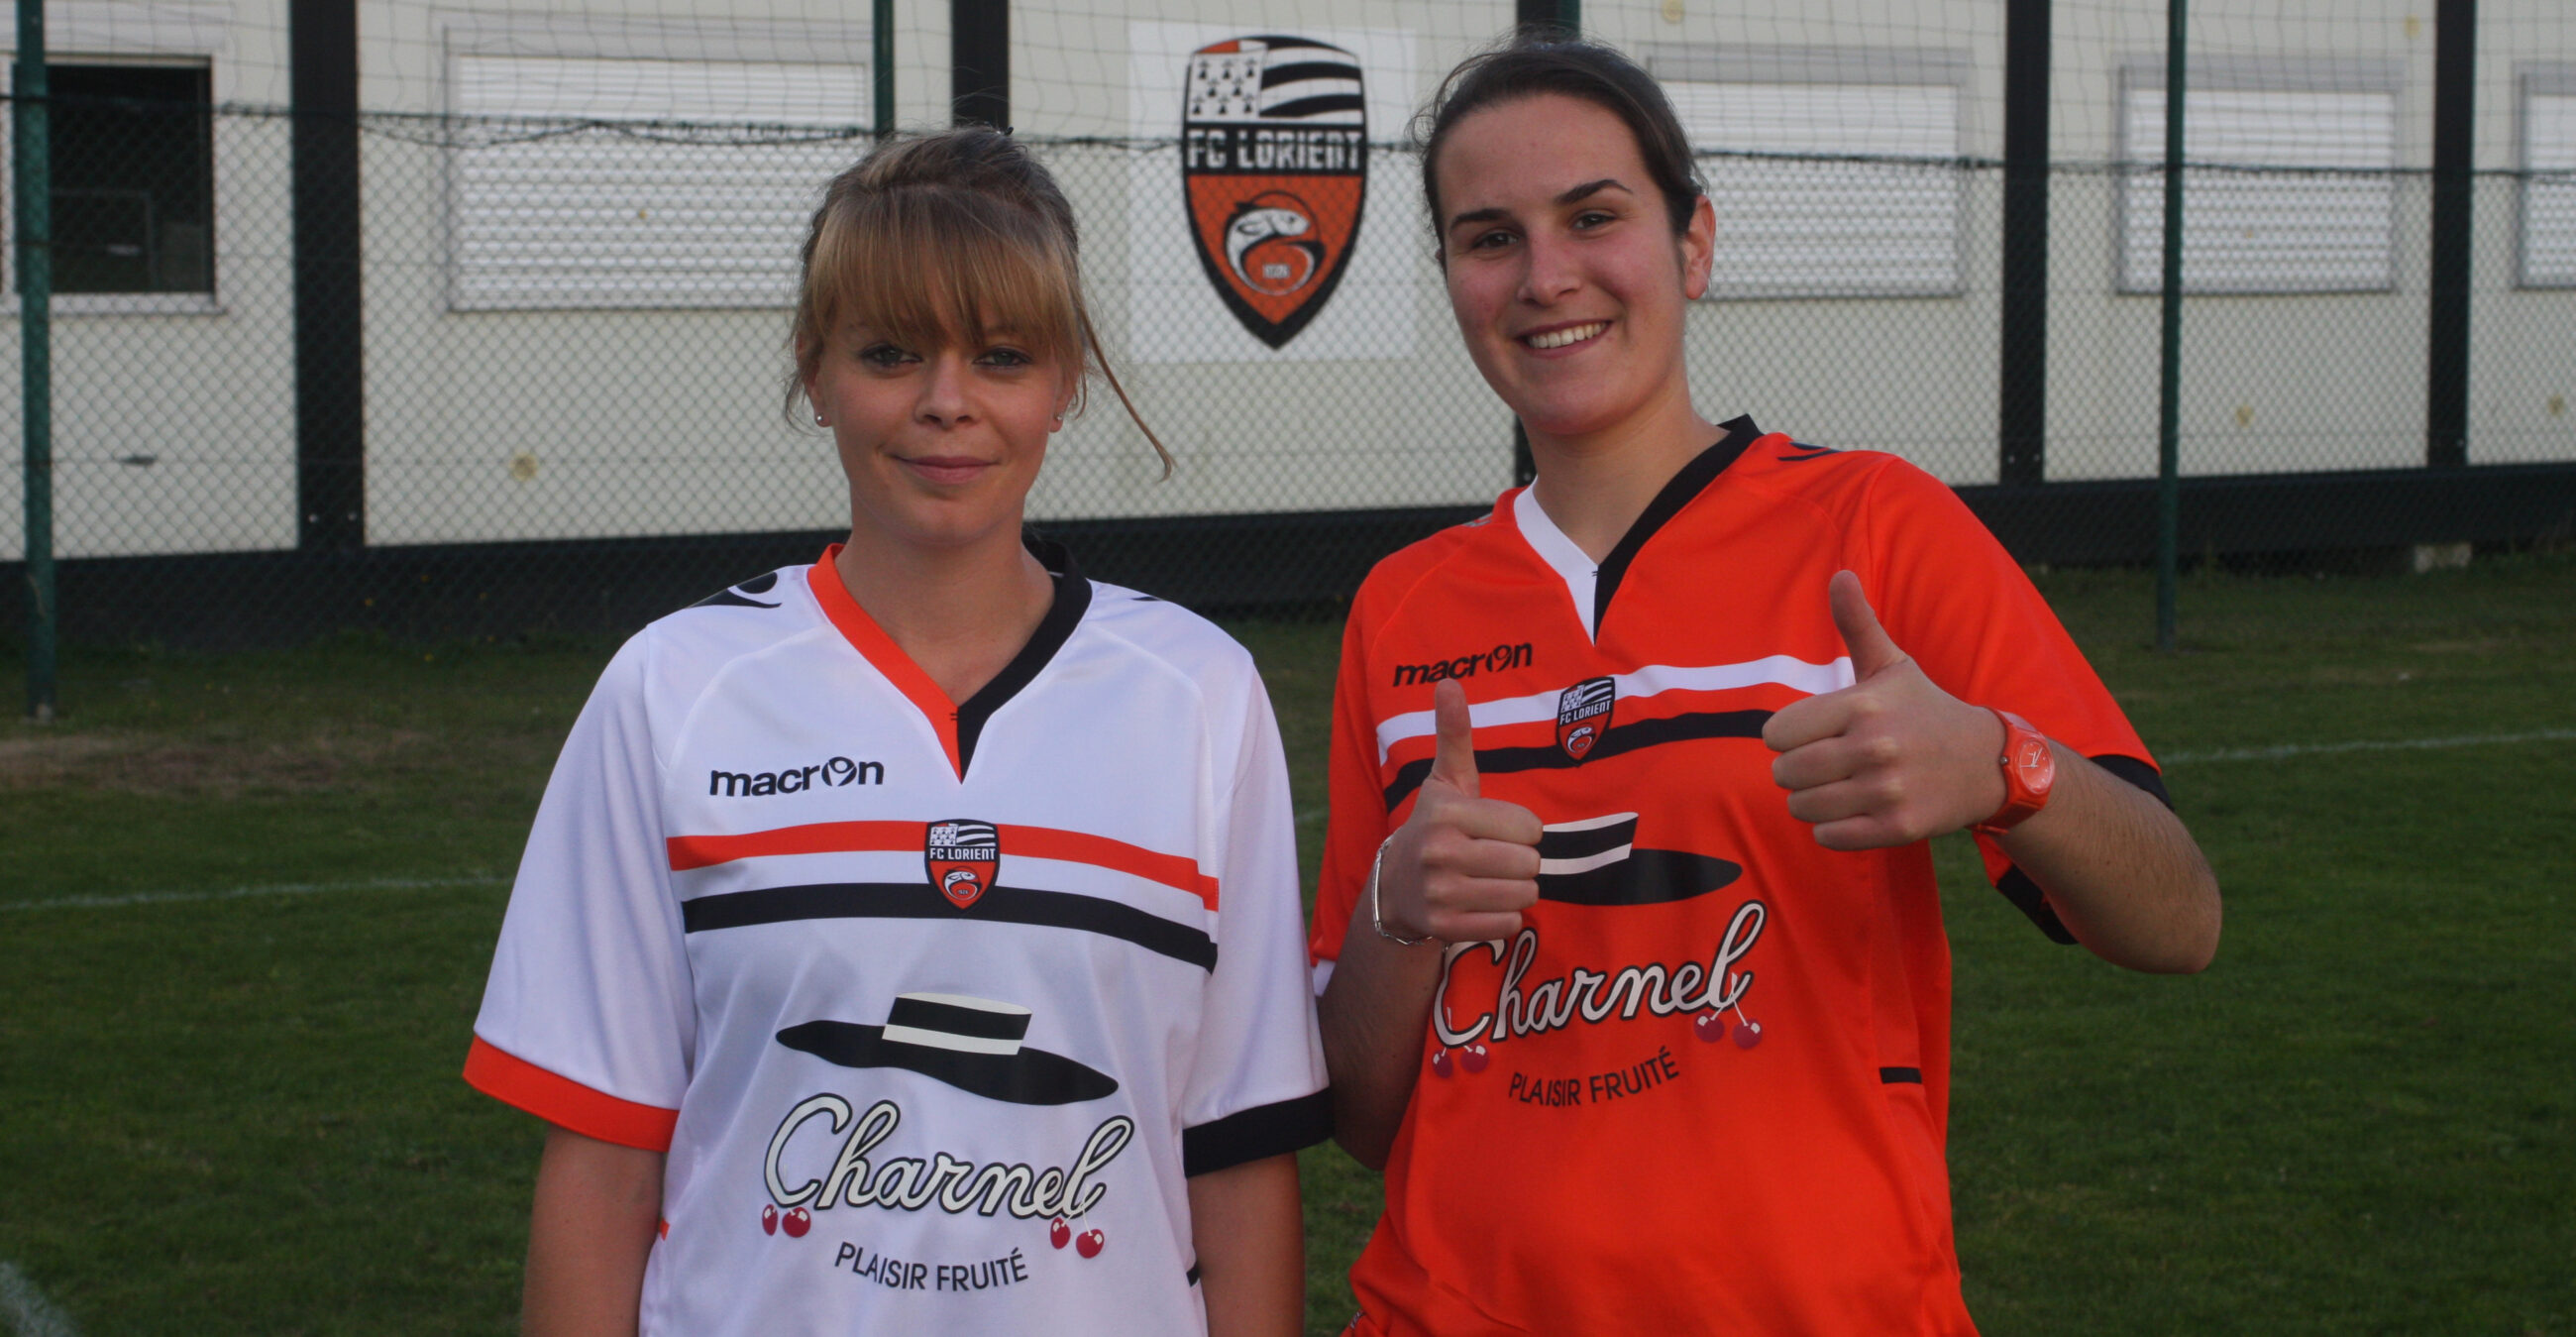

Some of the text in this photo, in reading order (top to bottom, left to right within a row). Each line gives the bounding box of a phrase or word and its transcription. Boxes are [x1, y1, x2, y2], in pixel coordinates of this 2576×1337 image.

[1188, 129, 1363, 169] FC LORIENT
[1392, 642, 1533, 687] macron
[1559, 700, 1611, 725] FC LORIENT
[709, 756, 885, 797] macron
[929, 847, 996, 860] FC LORIENT
[1433, 900, 1768, 1049] Charnel
[1508, 1046, 1680, 1107] PLAISIR FRUITÉ
[764, 1092, 1135, 1220] Charnel
[834, 1241, 1029, 1291] PLAISIR FRUITÉ
